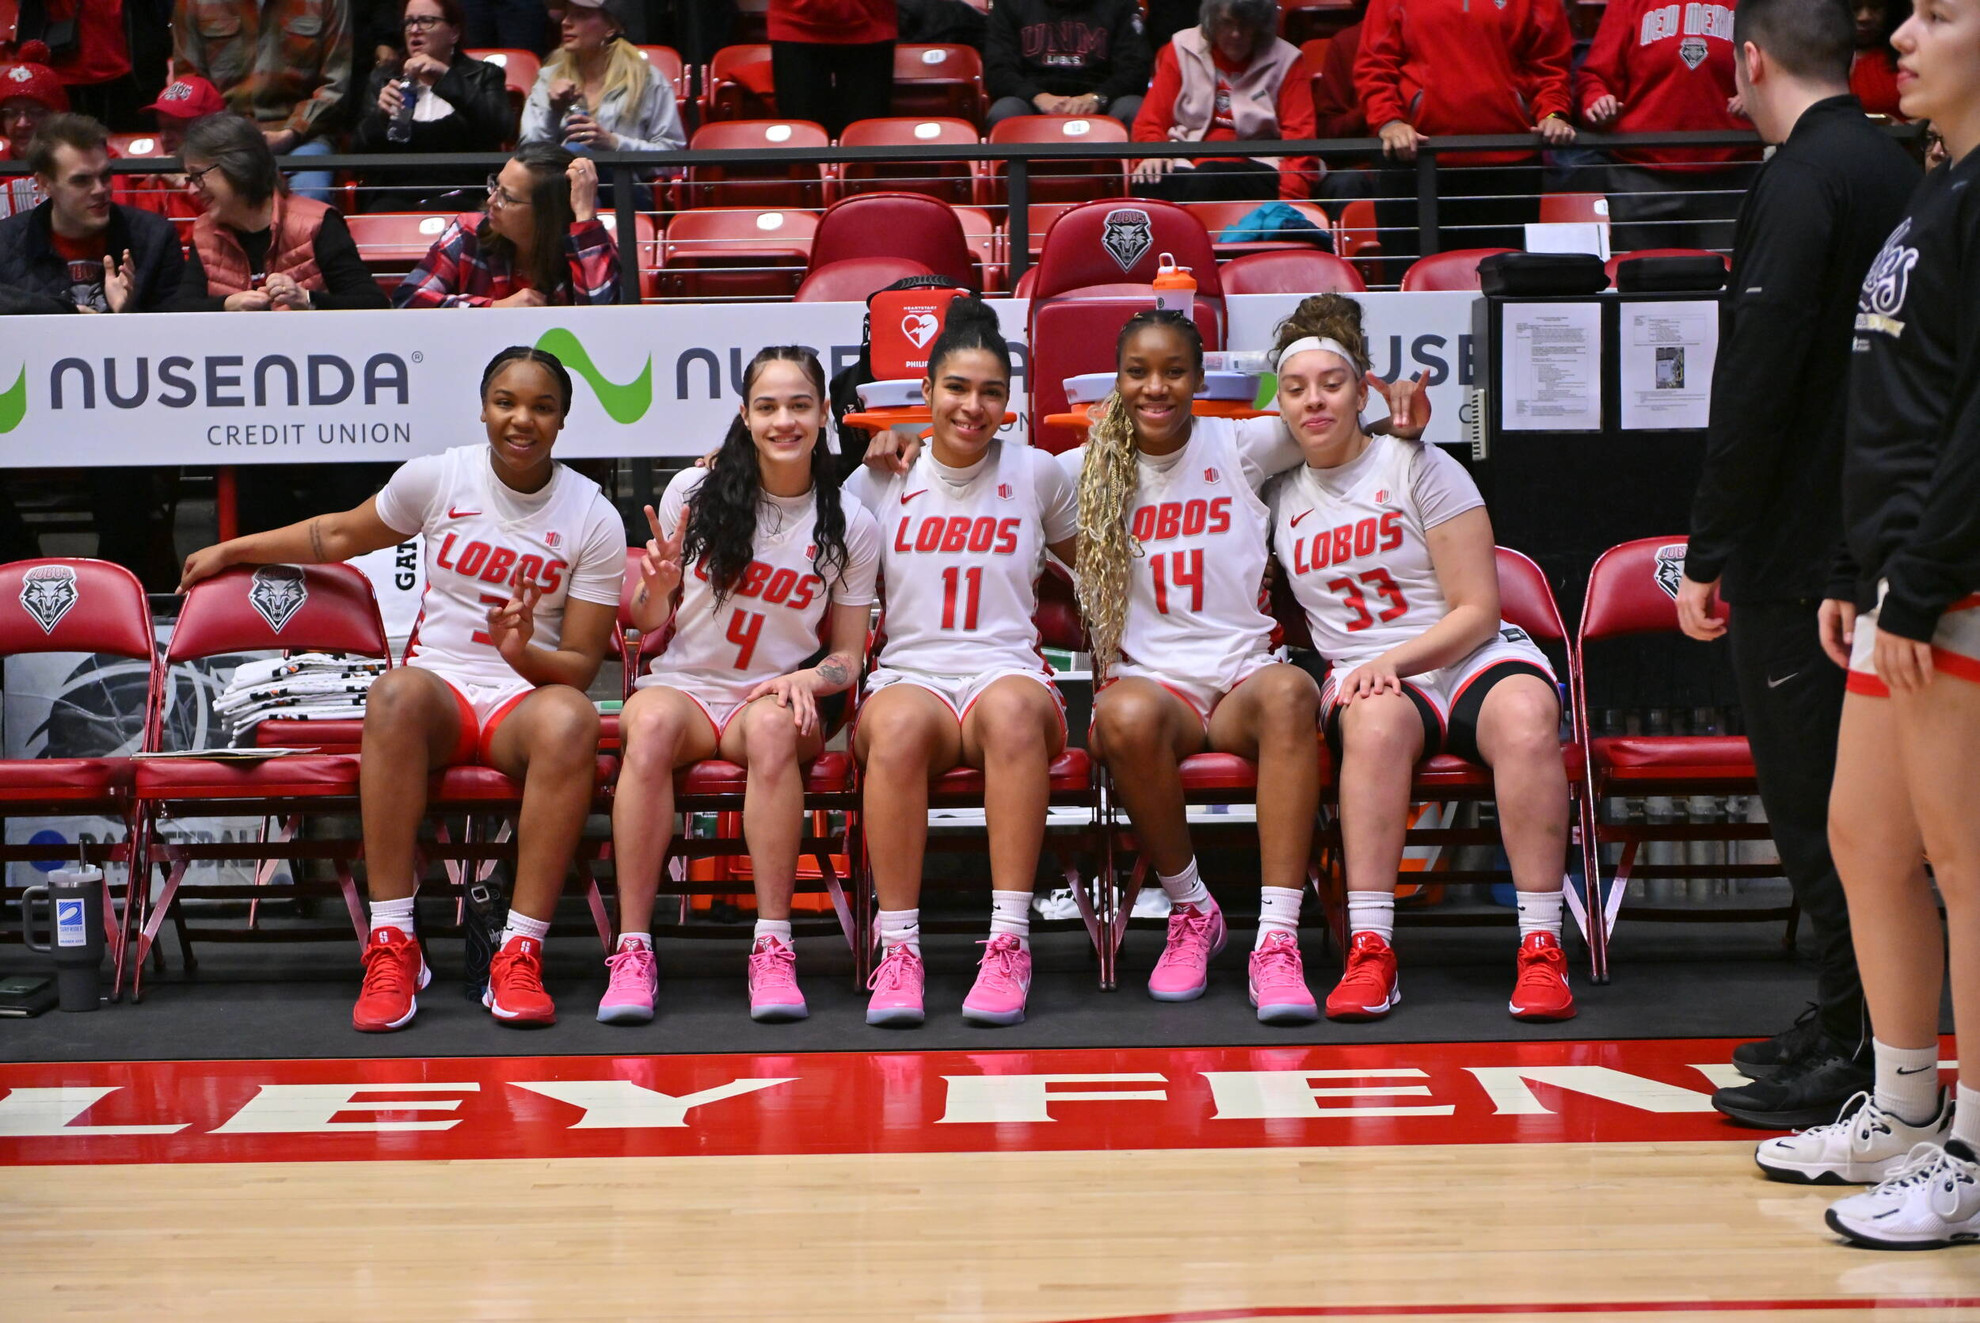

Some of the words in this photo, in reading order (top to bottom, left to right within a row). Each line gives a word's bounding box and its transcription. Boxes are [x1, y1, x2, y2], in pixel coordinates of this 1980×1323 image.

[1021, 21, 1108, 59] UNM
[1640, 4, 1680, 46] NEW
[207, 424, 305, 446] CREDIT
[318, 422, 411, 444] UNION
[894, 516, 1021, 555] LOBOS
[1131, 497, 1232, 542] OBOS
[1294, 511, 1404, 576] LOBOS
[436, 532, 569, 595] LOBOS
[694, 550, 822, 610] LBOS
[1149, 547, 1205, 615] 14
[941, 566, 980, 631] 11
[1327, 567, 1409, 633] 33
[725, 607, 766, 671] 4
